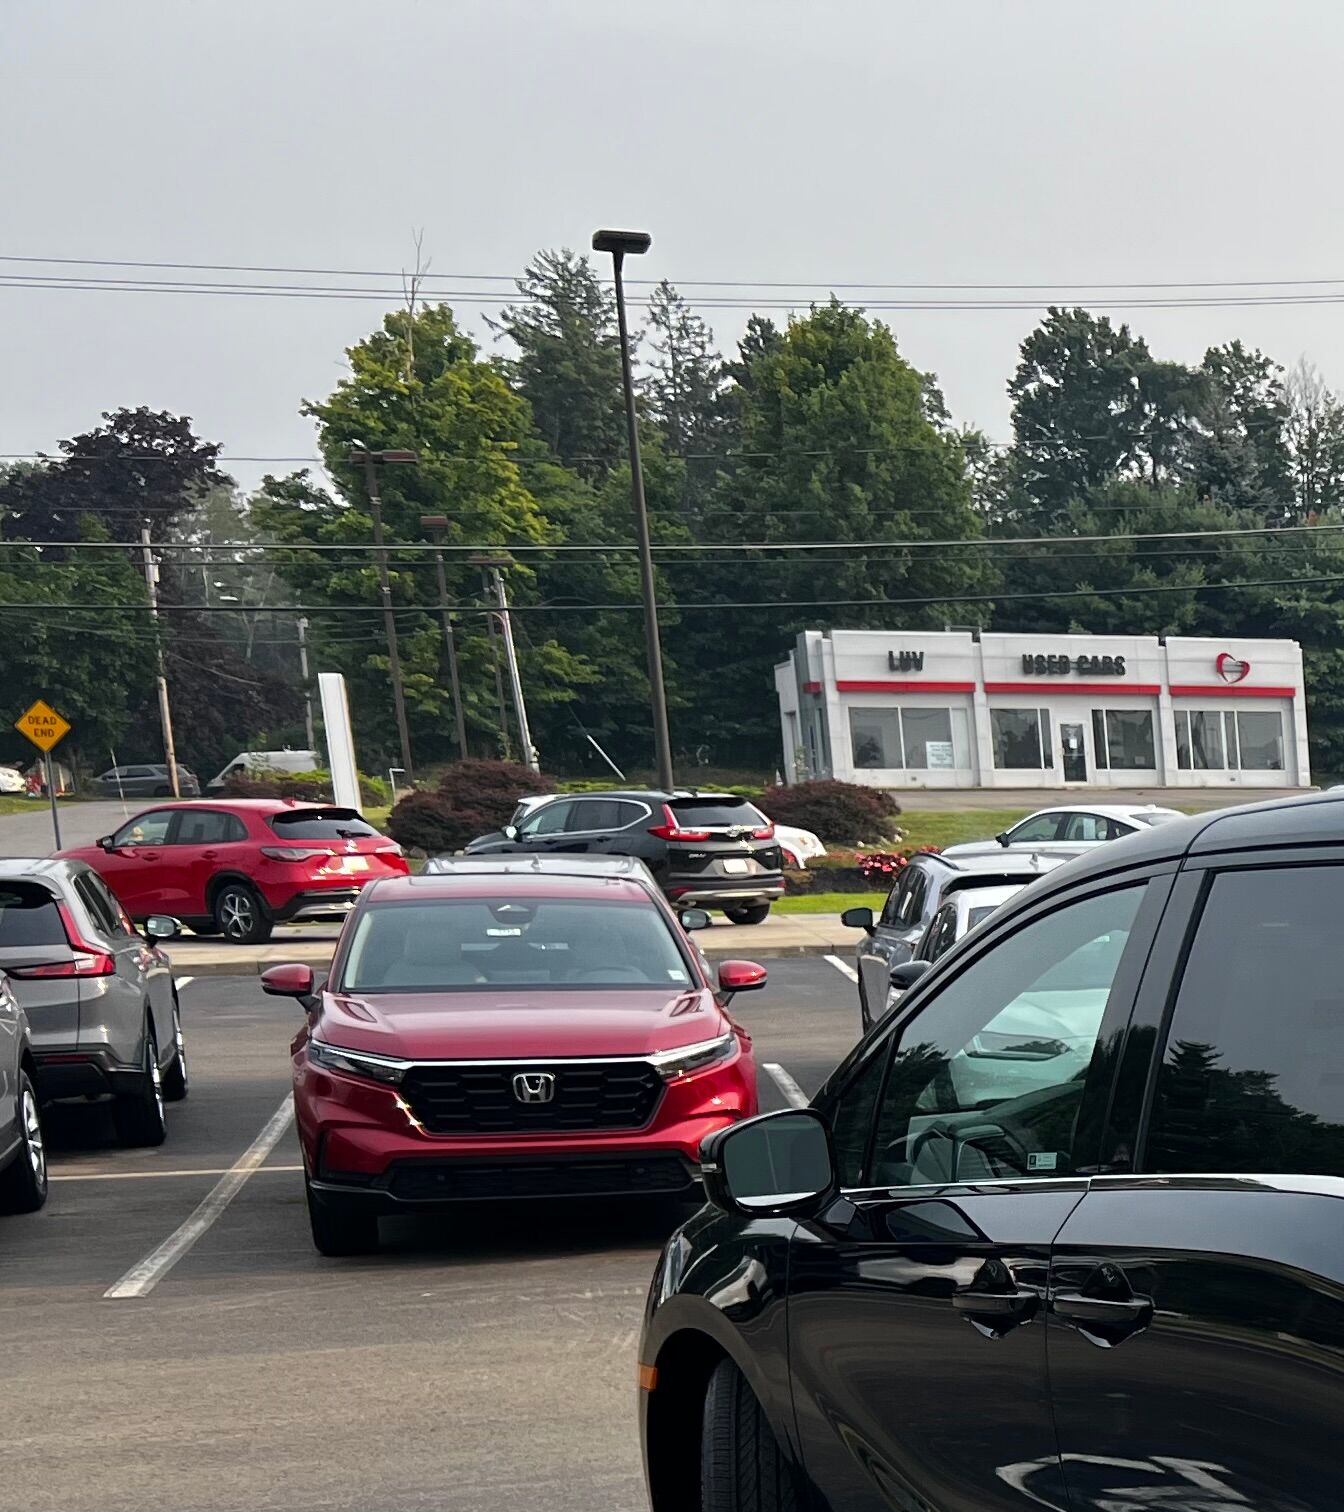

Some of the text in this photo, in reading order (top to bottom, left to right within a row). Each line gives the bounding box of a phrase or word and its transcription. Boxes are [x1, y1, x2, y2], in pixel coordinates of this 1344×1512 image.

[888, 650, 924, 672] LUV
[1022, 654, 1126, 677] USED CARS
[27, 716, 57, 726] DEAD
[33, 728, 55, 738] END
